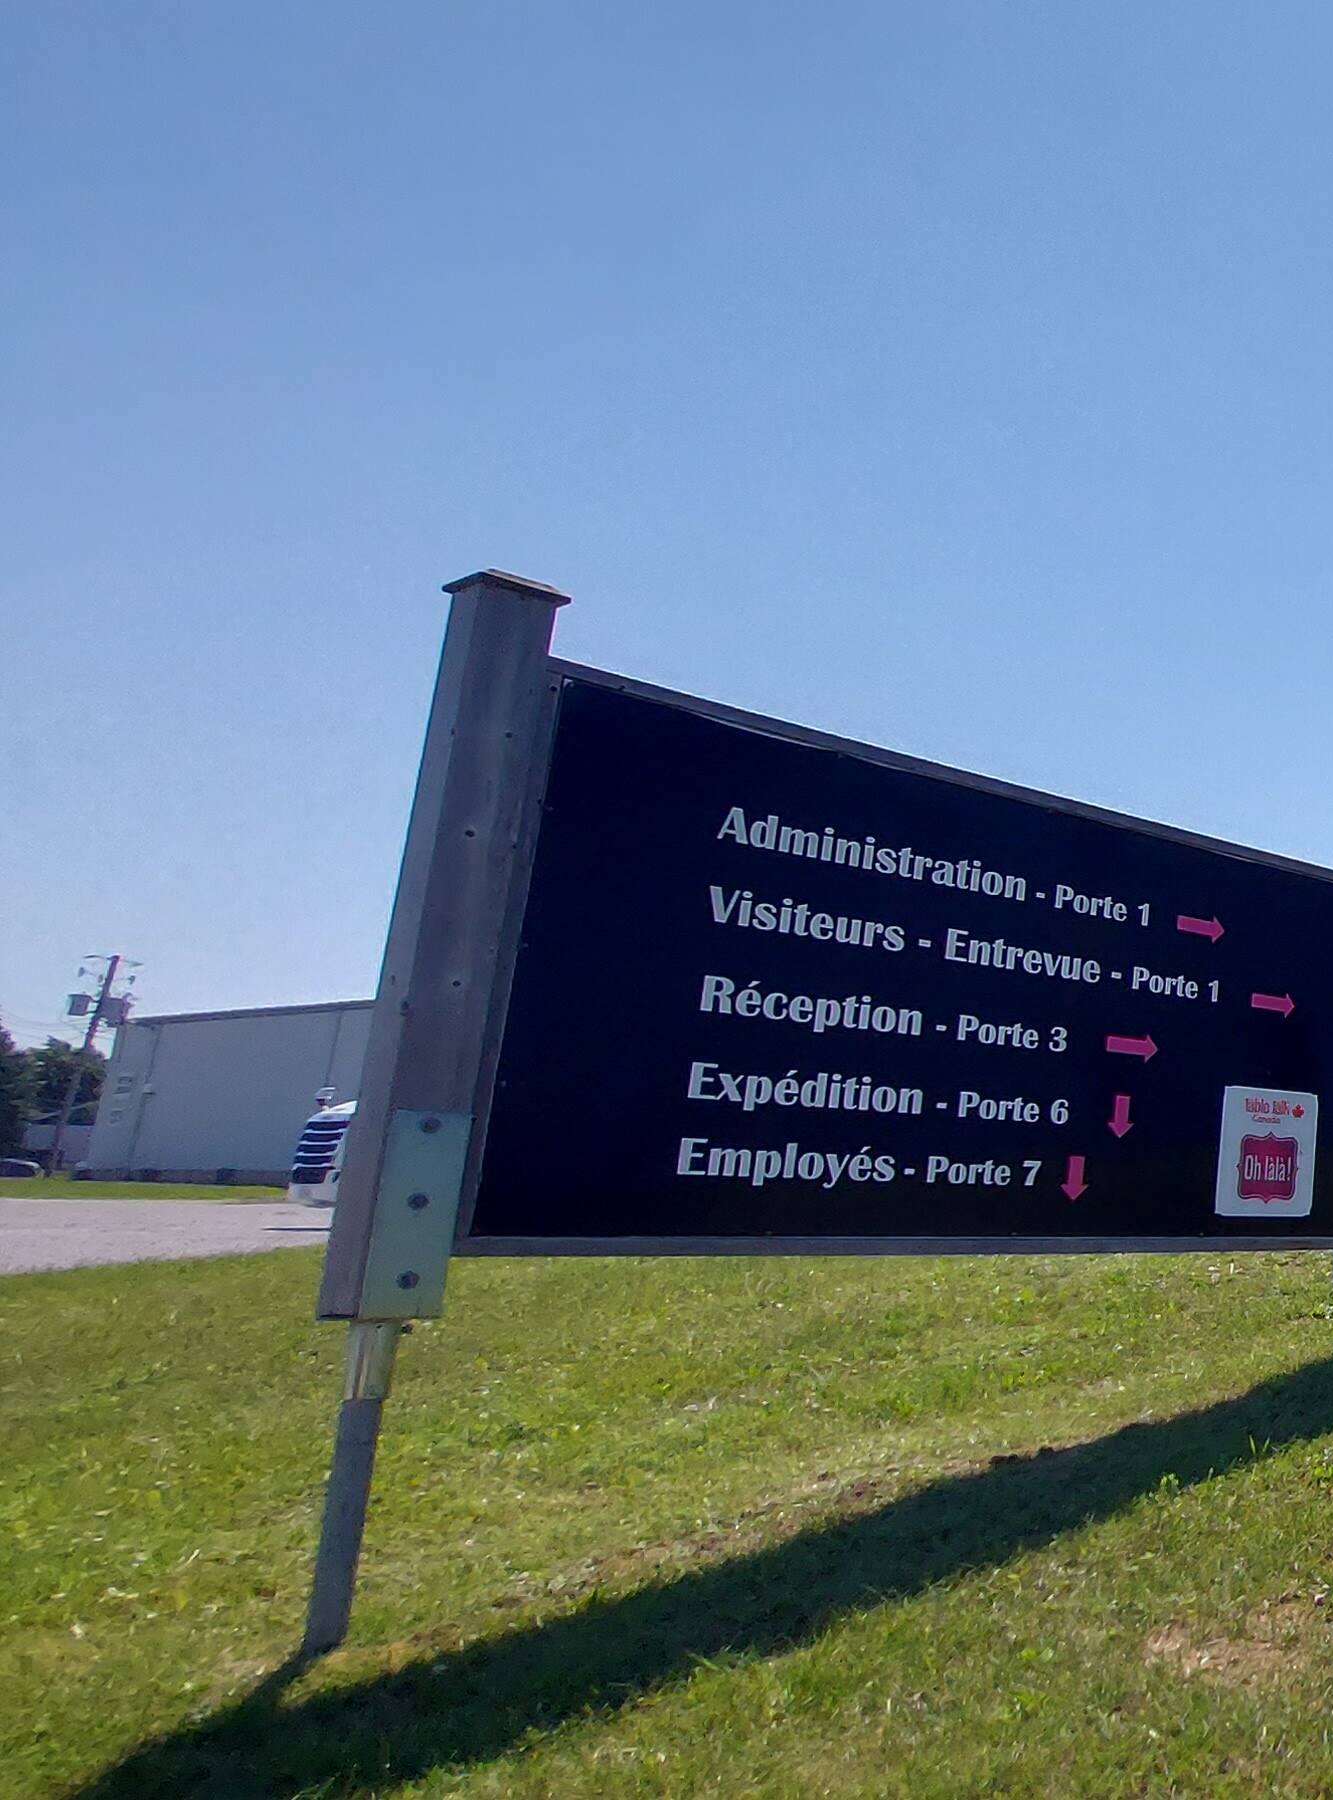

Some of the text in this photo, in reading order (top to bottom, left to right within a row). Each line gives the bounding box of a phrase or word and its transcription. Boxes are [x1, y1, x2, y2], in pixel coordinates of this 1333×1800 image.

[716, 806, 1027, 902] Administration
[1054, 884, 1128, 922] Porte
[1137, 903, 1150, 927] 1
[709, 885, 906, 952] Visiteurs
[944, 927, 1101, 984] Entrevue
[1131, 965, 1199, 999] Porte
[1207, 979, 1219, 1003] 1
[699, 974, 923, 1036] Réception
[956, 1014, 1039, 1050] Porte
[1048, 1026, 1068, 1052] 3
[687, 1061, 924, 1115] Expédition
[957, 1090, 1040, 1124] Porte
[1050, 1098, 1069, 1125] 6
[676, 1137, 896, 1189] Employés
[926, 1155, 1011, 1186] Porte
[1022, 1160, 1042, 1186] 7
[1244, 1155, 1261, 1180] Oh
